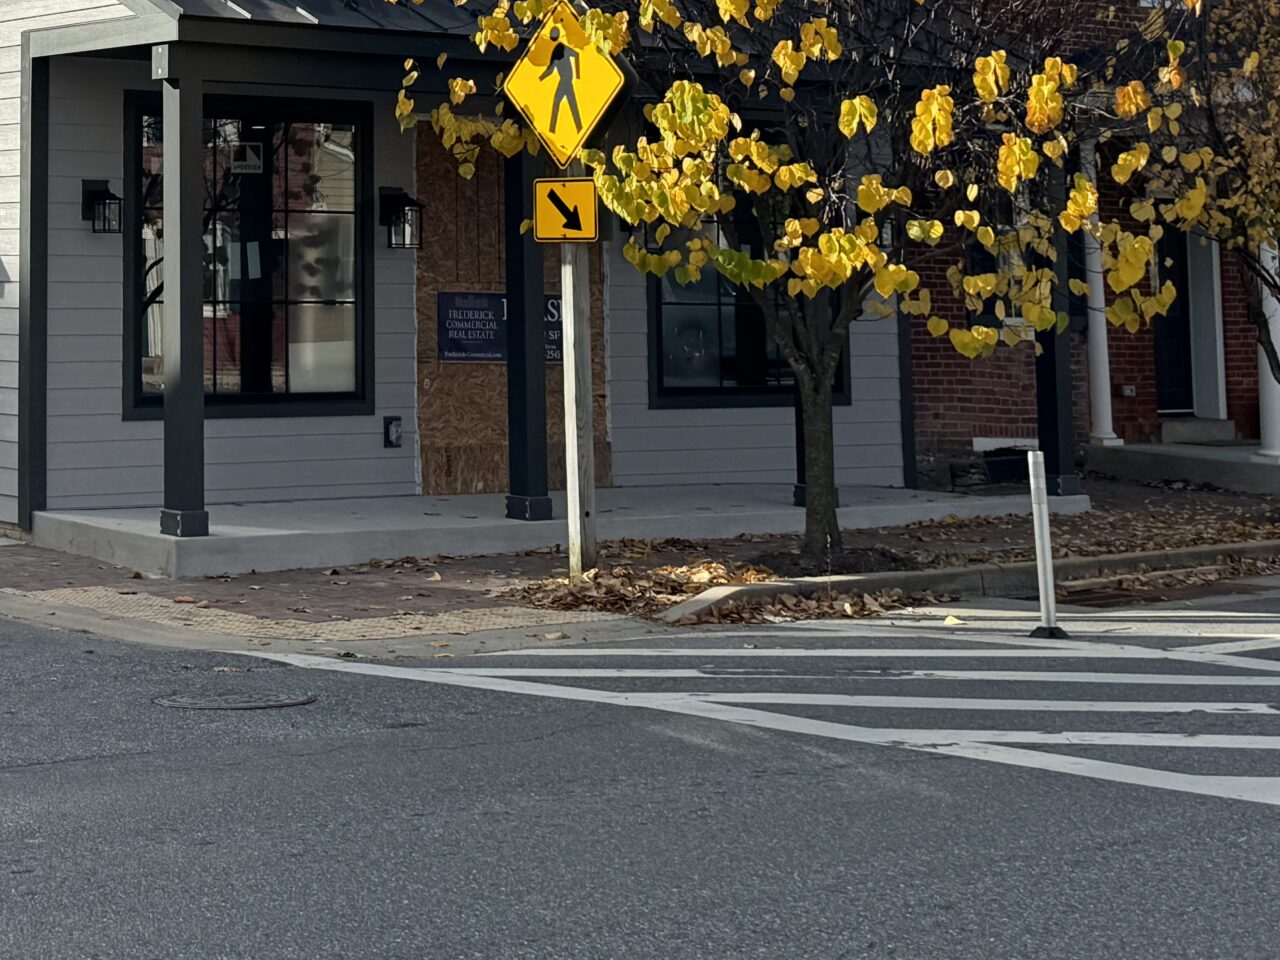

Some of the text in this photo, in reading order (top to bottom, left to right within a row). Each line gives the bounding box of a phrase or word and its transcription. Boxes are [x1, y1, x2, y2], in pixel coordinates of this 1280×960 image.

[448, 310, 495, 319] FREDERICK
[445, 320, 498, 329] COMMERCIAL
[448, 330, 495, 339] REAL ESTATE
